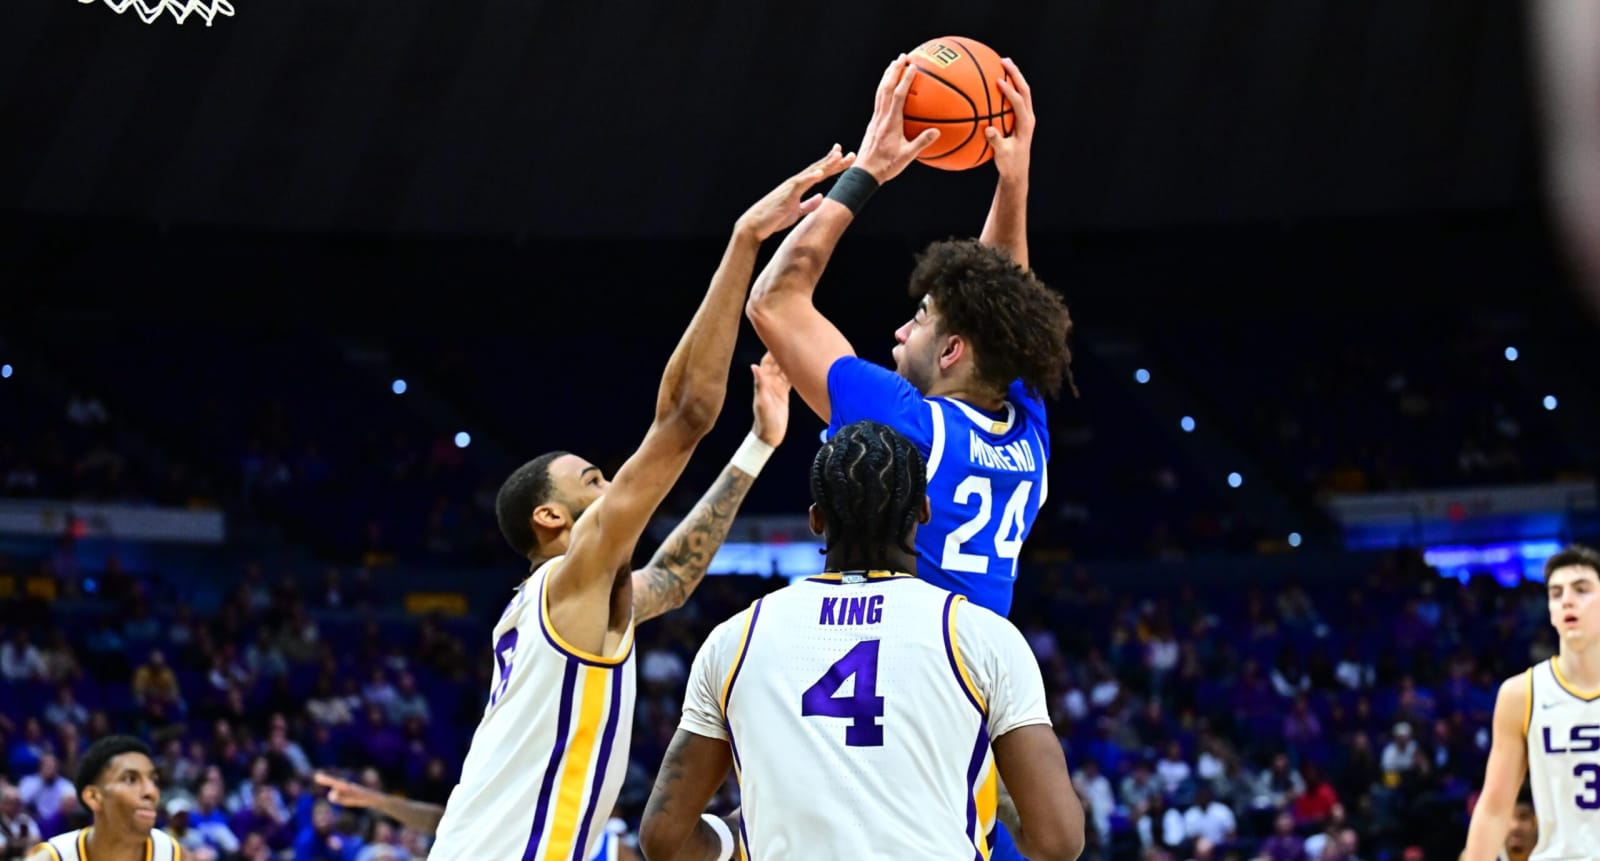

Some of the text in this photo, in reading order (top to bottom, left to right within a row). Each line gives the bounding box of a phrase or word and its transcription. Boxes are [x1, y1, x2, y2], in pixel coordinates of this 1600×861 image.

[969, 430, 1035, 472] MORENO
[941, 475, 1033, 577] 24
[819, 594, 884, 625] KING
[802, 639, 884, 747] 4
[1573, 763, 1600, 810] 3
